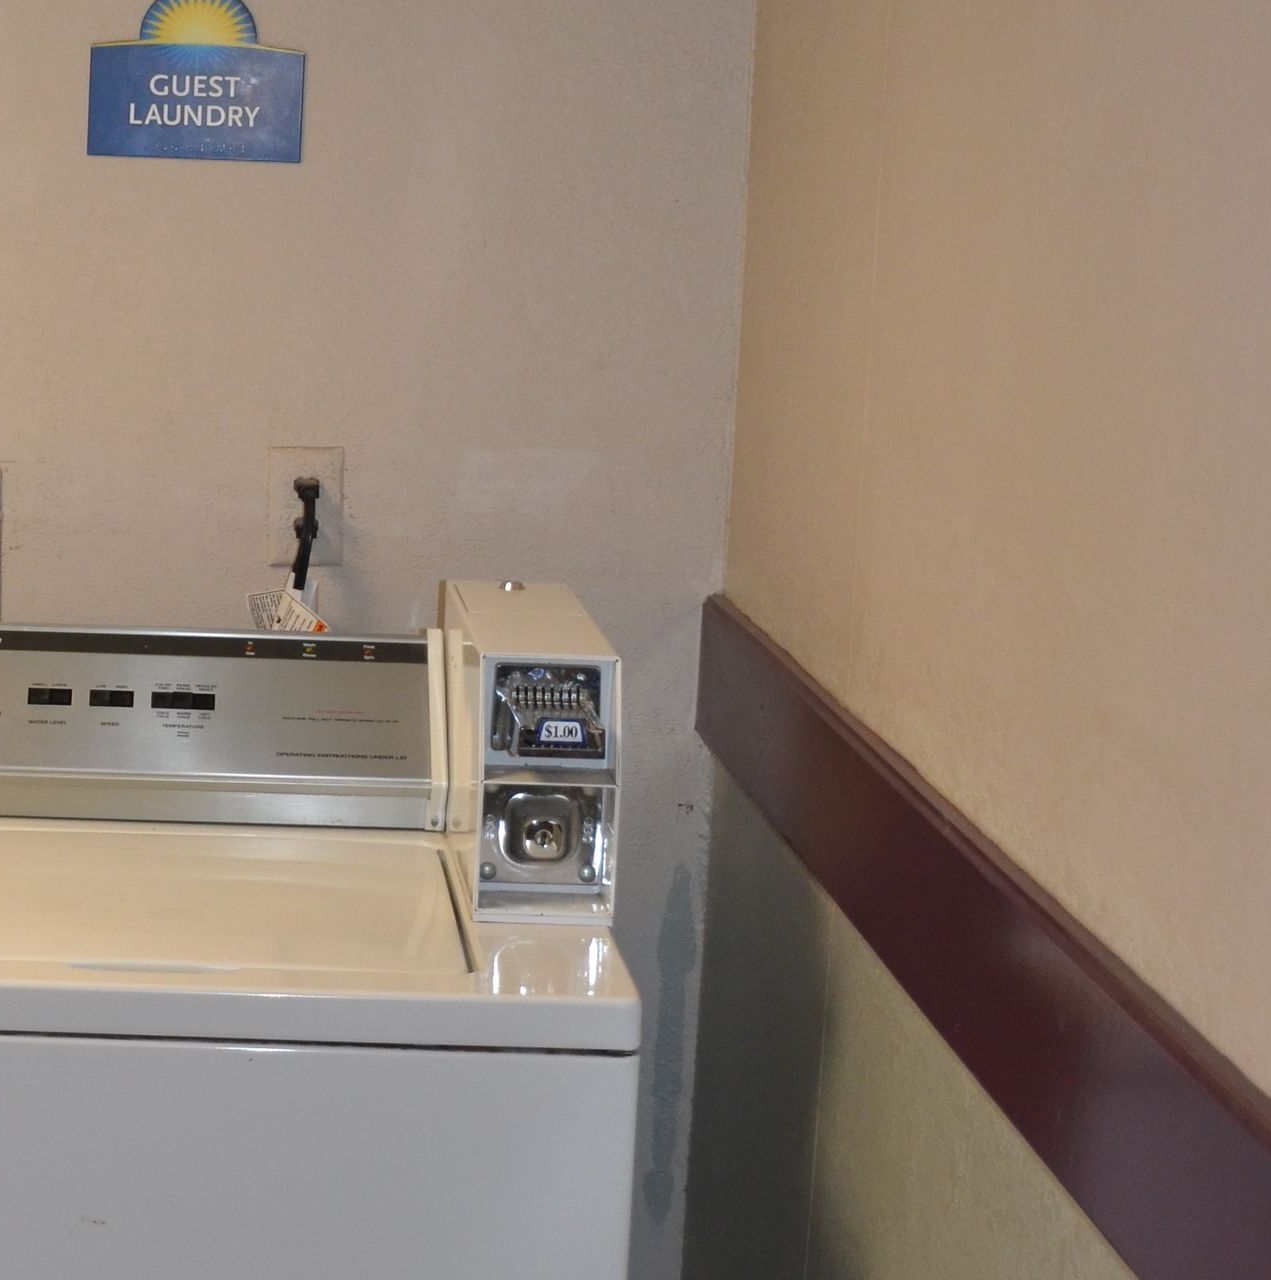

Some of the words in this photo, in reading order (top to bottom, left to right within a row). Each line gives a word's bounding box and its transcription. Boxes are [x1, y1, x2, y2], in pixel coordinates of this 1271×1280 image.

[149, 73, 241, 98] GUEST
[128, 102, 260, 128] LAUNDRY
[543, 723, 579, 741] $1.00
